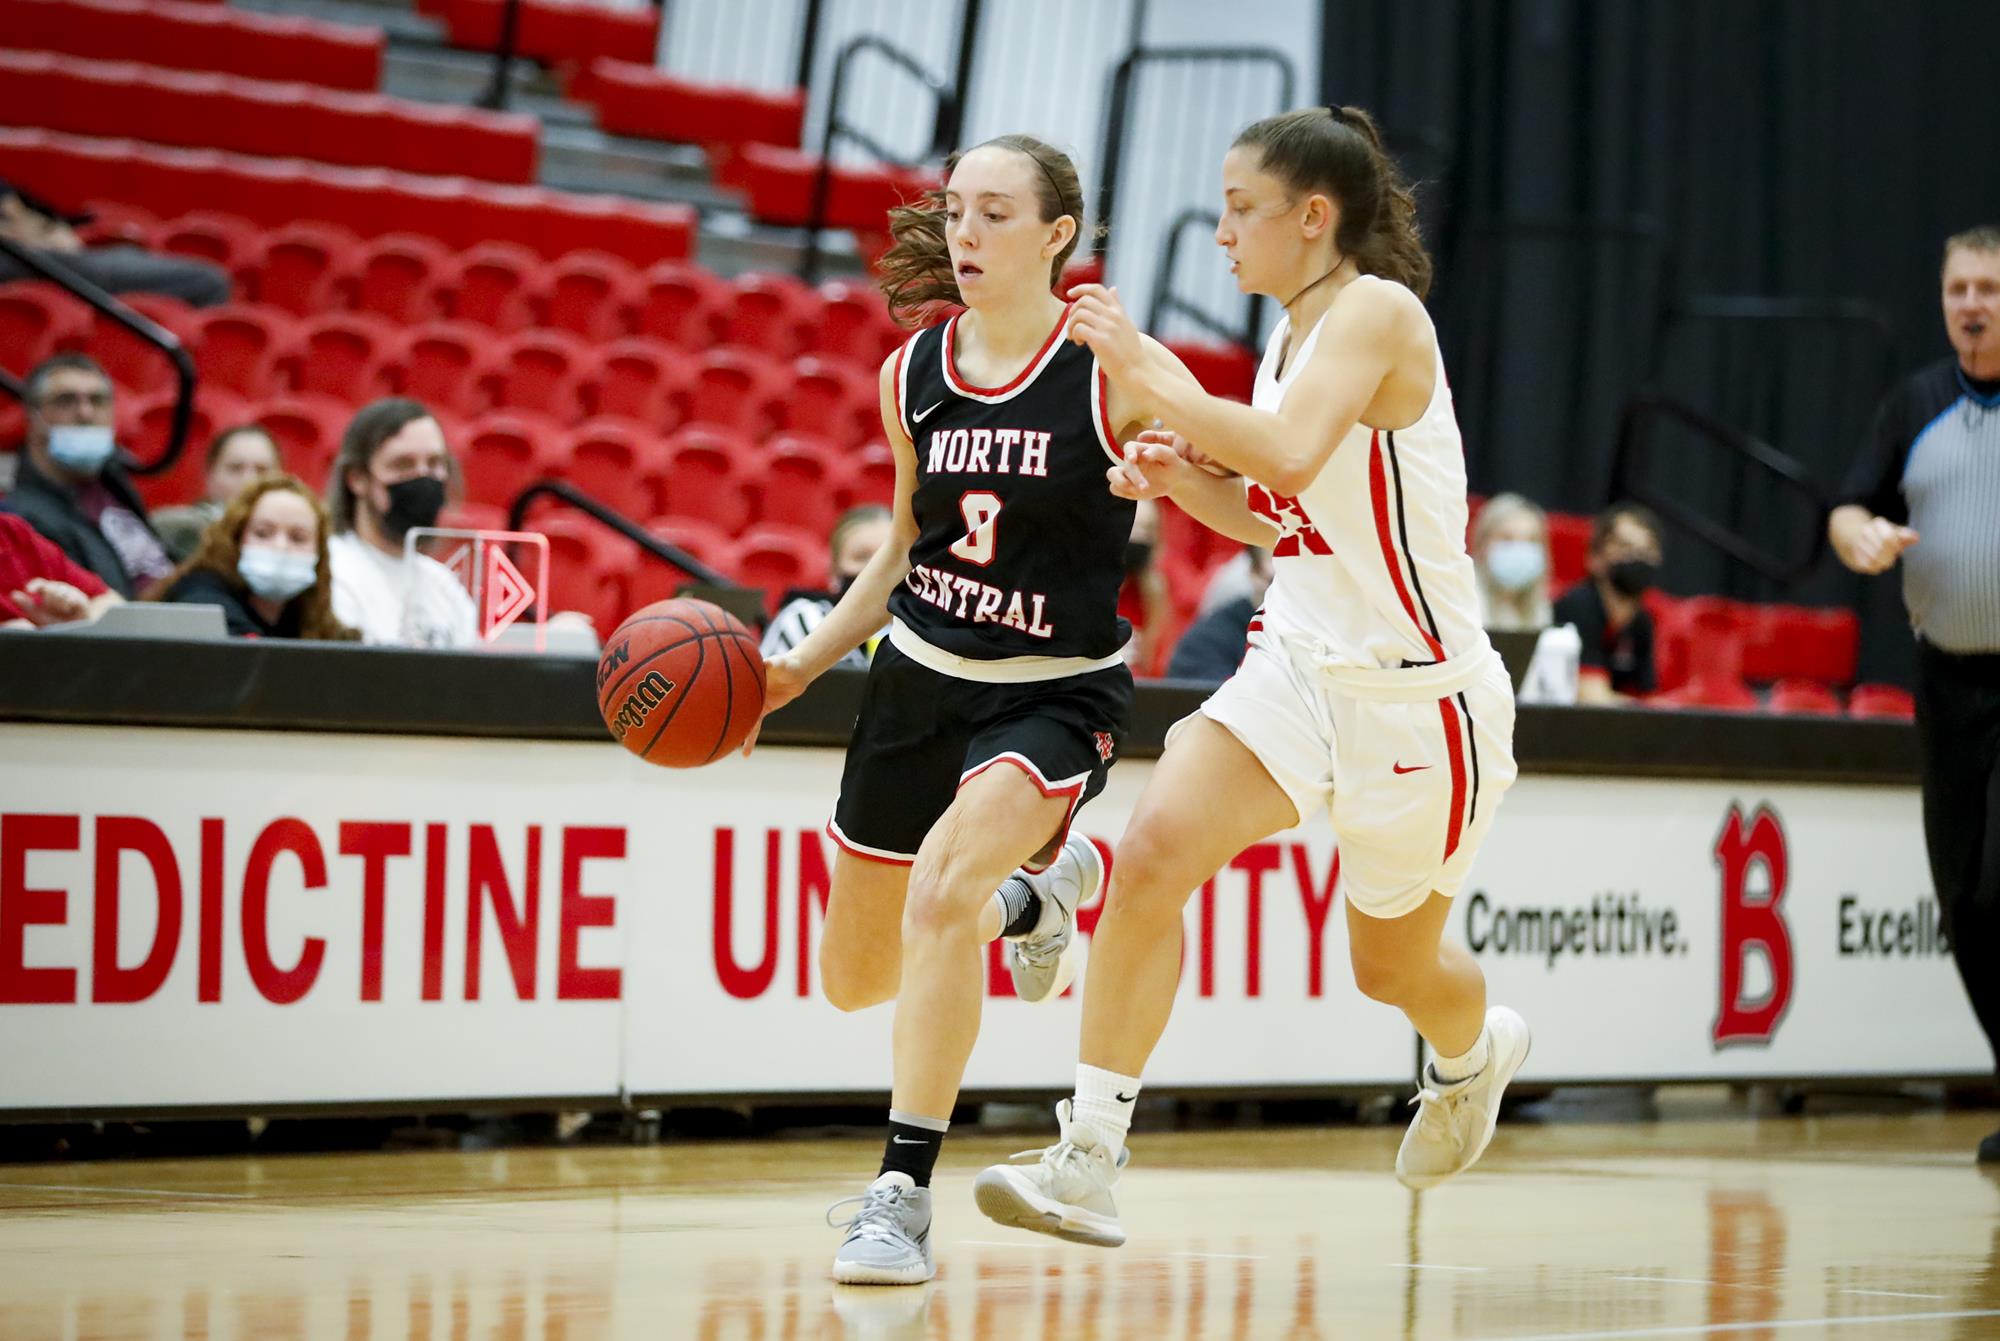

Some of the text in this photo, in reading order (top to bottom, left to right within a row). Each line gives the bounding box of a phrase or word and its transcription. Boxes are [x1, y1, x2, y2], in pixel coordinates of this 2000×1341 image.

[926, 428, 1052, 477] NORTH
[949, 490, 1003, 567] 0
[609, 670, 676, 738] Wilso
[0, 813, 627, 1005] EDICTINE
[1466, 890, 1688, 971] Competitive.
[1712, 799, 1797, 1054] B
